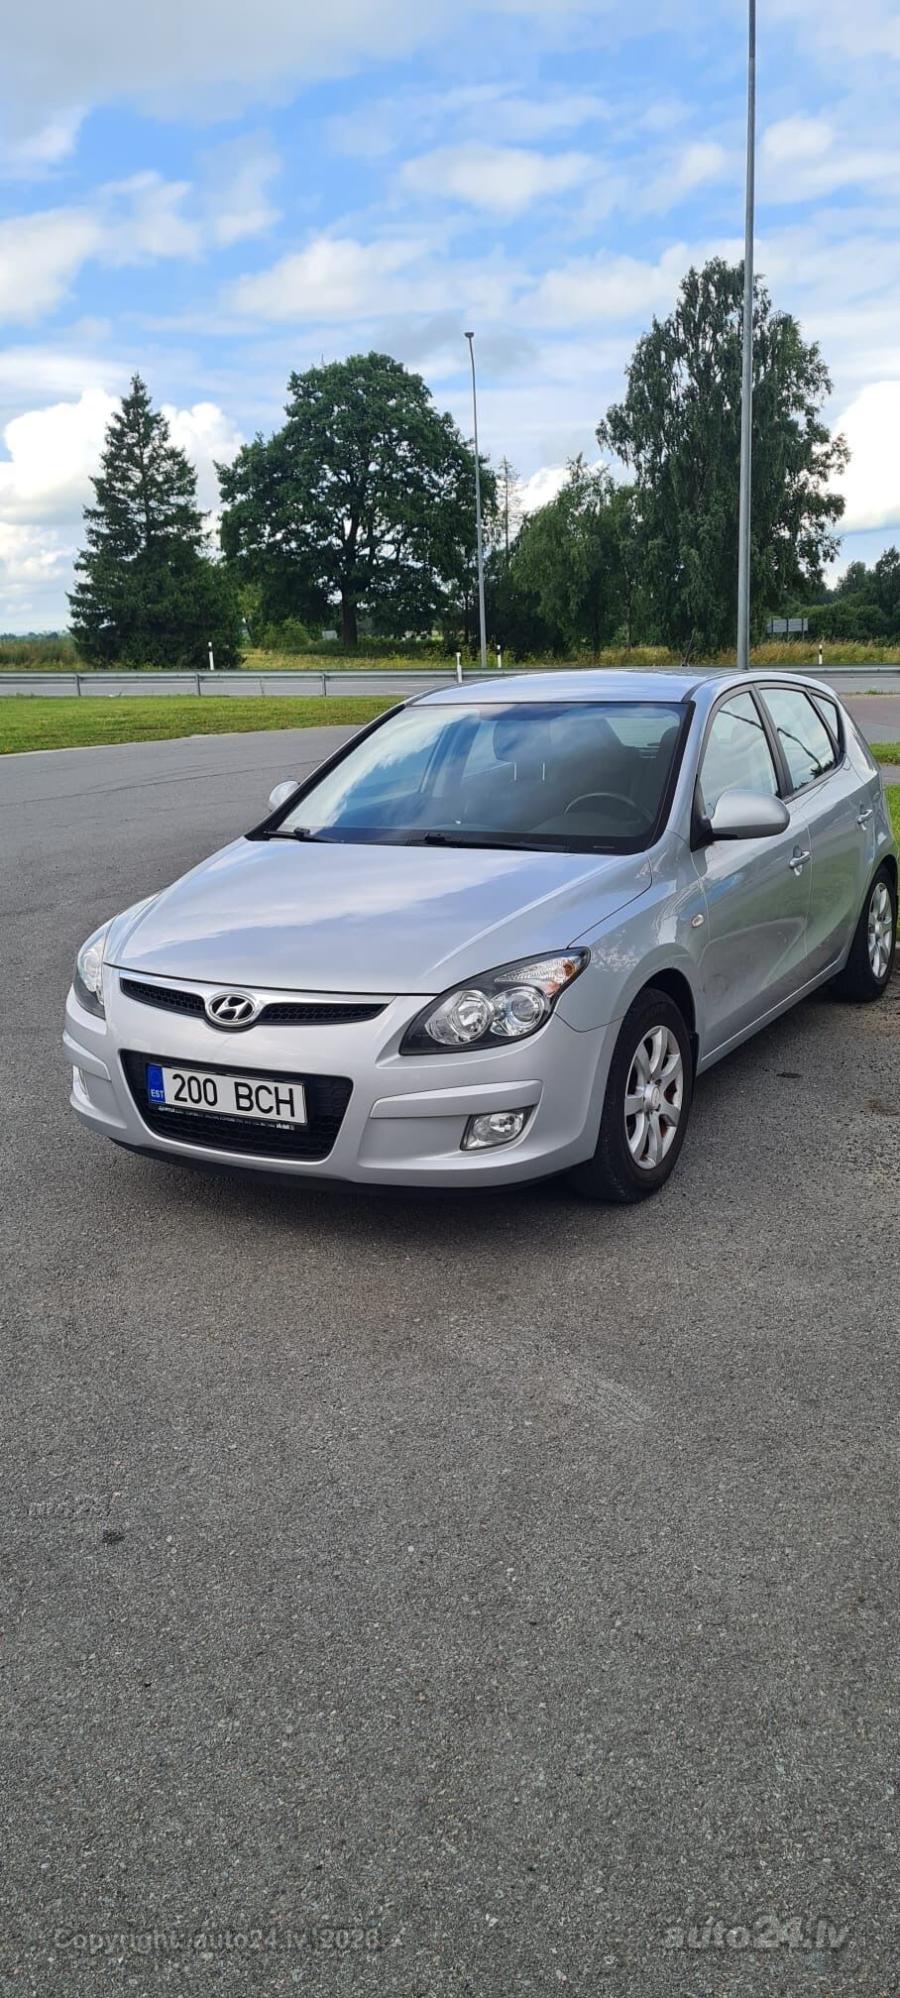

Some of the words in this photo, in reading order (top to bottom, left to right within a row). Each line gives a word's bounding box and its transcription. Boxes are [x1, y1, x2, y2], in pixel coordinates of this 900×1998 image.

[150, 1089, 165, 1099] EST
[172, 1073, 218, 1107] 200
[234, 1081, 296, 1118] BCH
